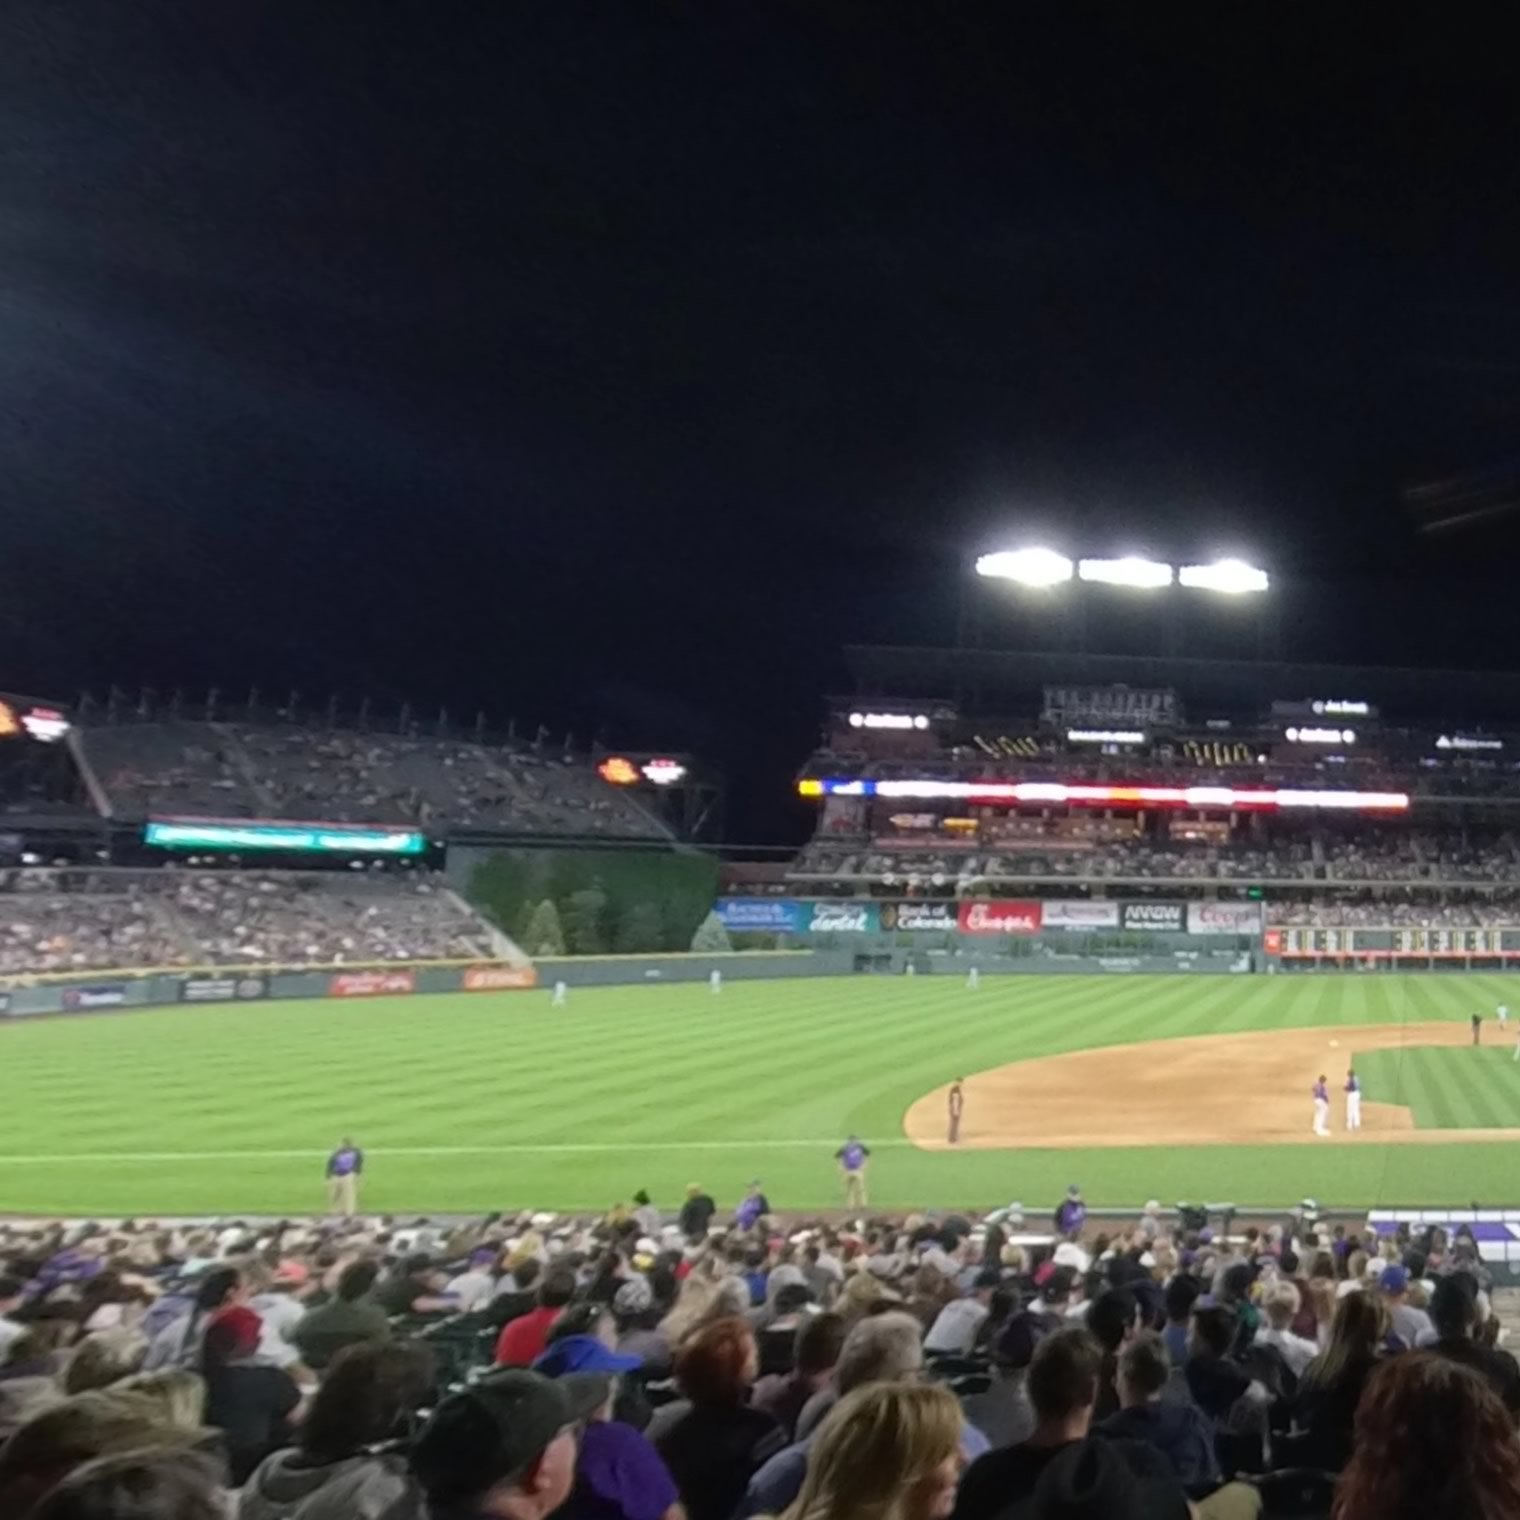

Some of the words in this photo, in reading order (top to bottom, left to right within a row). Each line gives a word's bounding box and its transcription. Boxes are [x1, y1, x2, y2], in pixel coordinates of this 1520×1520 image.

[898, 903, 930, 916] Bank
[1124, 904, 1182, 920] ARROW
[898, 916, 958, 929] Colorado
